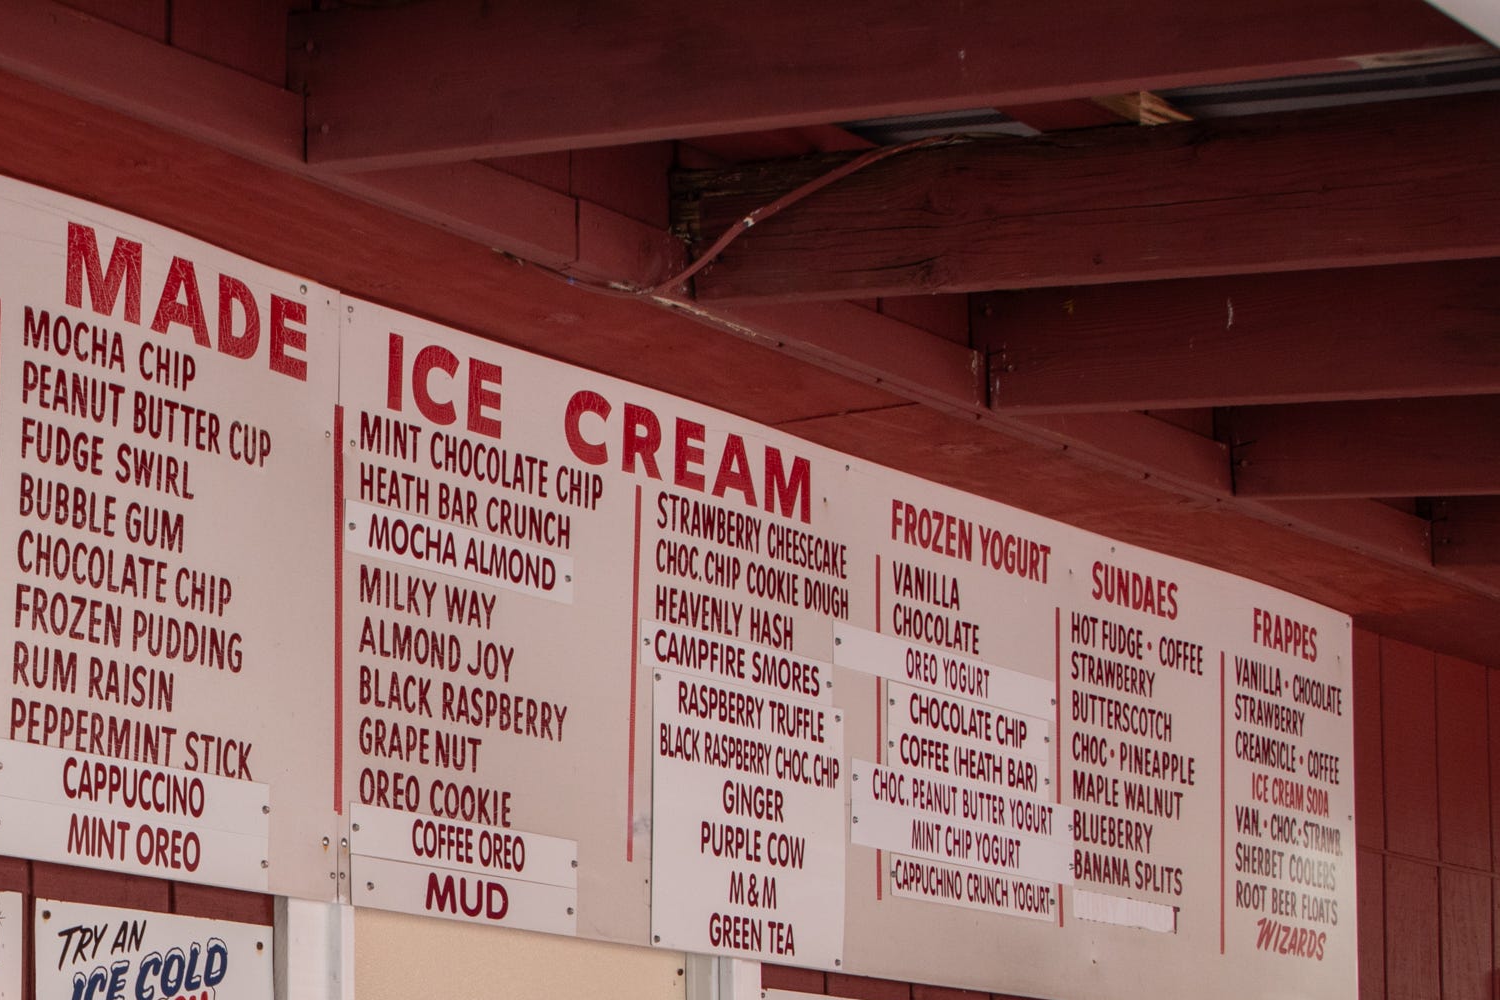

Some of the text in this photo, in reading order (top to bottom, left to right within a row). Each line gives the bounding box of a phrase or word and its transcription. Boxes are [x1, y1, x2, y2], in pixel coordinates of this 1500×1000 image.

[23, 305, 196, 392] MOCHA CHIP
[65, 220, 308, 382] MADE
[387, 332, 502, 440] ICE
[564, 389, 812, 525] CREAM
[21, 416, 195, 500] FUDGE SWIRL
[19, 472, 184, 553] BUBBLE GUM
[360, 462, 571, 549] HEATH BAR CRUNCH
[368, 513, 556, 591] MOCHA ALMOND
[657, 491, 847, 579] STRAWBERRY CHEESECAKE
[891, 498, 1051, 585] FROZEN YOGURT
[893, 560, 960, 611] VANILLA
[1091, 561, 1179, 621] SUNDAES
[893, 603, 980, 655] CHOCOLATE
[1253, 607, 1318, 663] FRAPPES
[654, 629, 820, 697] CAMPFIRE SMORES
[1071, 651, 1156, 698] STRAWBERRY
[359, 665, 567, 742] BLACK RASPBERRY
[909, 692, 1027, 749] CHOCOLATE CHIP
[1072, 690, 1172, 743] BUTTERSCOTCH
[1234, 693, 1305, 738] STRAWBERRY
[62, 757, 205, 818] CAPPUCCINO
[723, 780, 784, 823] GINGER
[1252, 772, 1329, 818] ICE CREAM SODA
[67, 813, 201, 872] MINT OREO
[700, 821, 805, 870] PURPLE COW
[911, 818, 1021, 869] MINT CHIP YOGURT
[1073, 809, 1153, 854] BLUEBERRY
[425, 872, 509, 920] MUD
[1235, 880, 1338, 926] ROOT BEER FLOATS
[709, 912, 796, 957] GREEN TEA
[1256, 917, 1327, 961] WIZARDS
